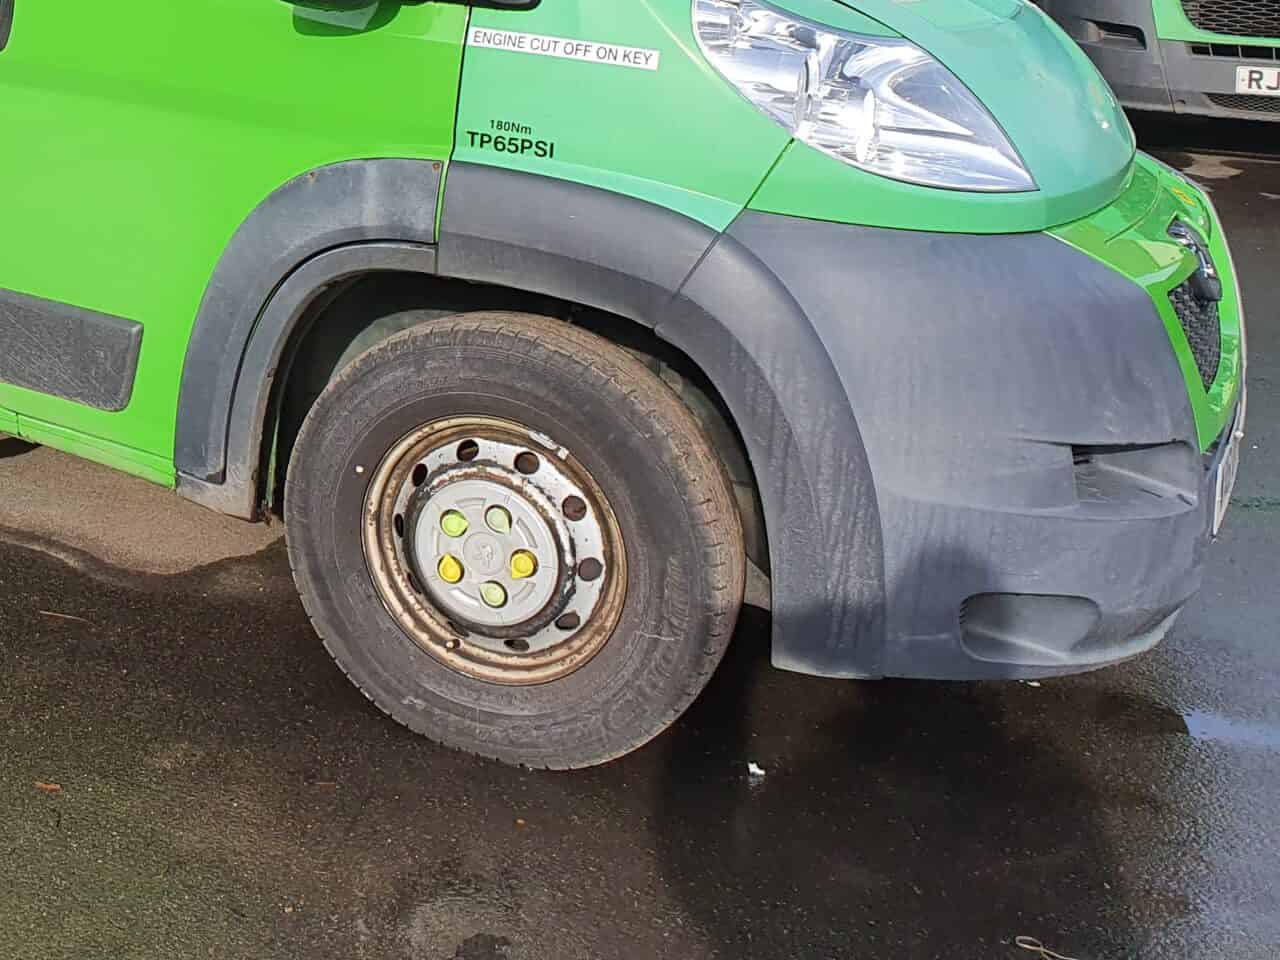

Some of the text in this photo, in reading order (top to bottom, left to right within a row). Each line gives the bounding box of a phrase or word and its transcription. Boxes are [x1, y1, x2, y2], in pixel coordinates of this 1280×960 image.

[473, 30, 653, 66] ENGINE CUT OFF ON KEY
[489, 119, 532, 136] 180Nm
[466, 130, 555, 159] TP65PSI
